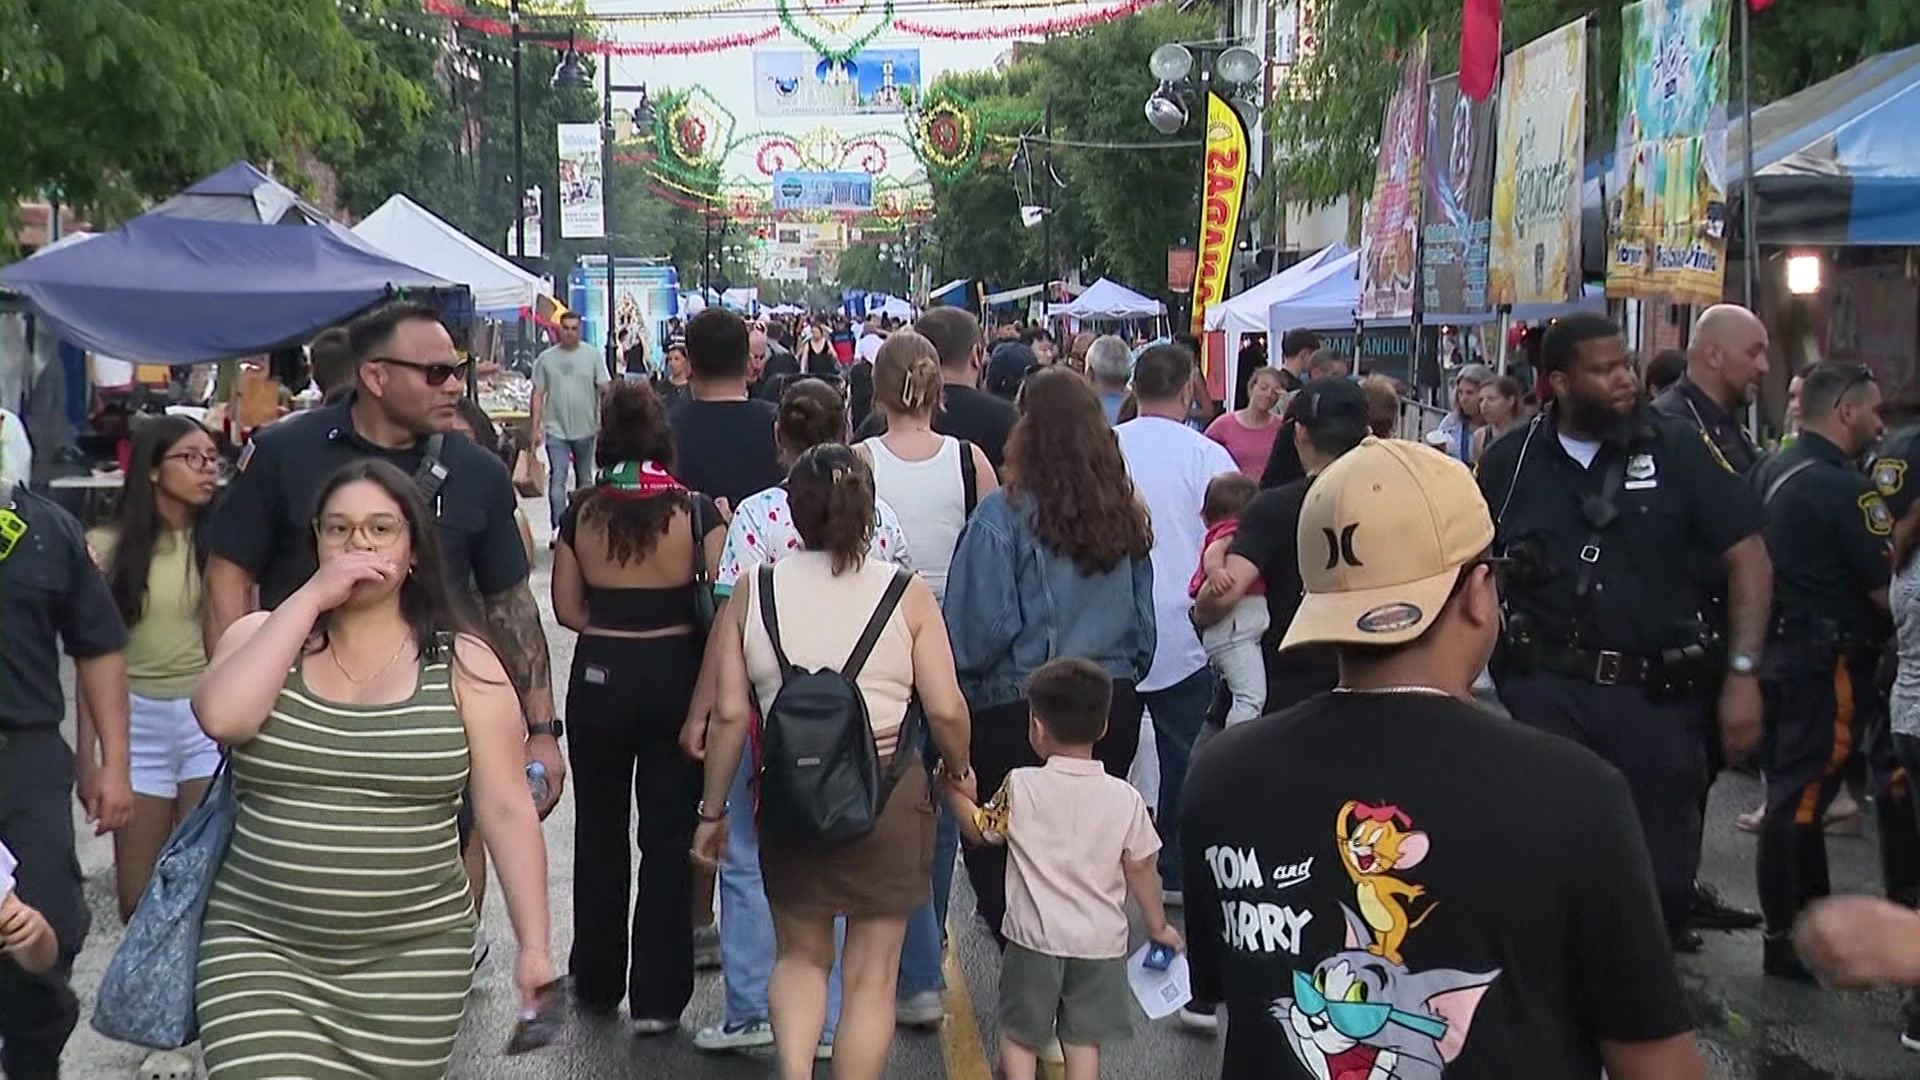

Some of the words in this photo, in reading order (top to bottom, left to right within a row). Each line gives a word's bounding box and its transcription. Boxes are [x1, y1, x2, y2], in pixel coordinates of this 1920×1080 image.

[1362, 337, 1429, 356] ANDWIH
[1205, 844, 1265, 890] TOM
[1273, 856, 1315, 881] and
[1221, 900, 1315, 956] JERRY
